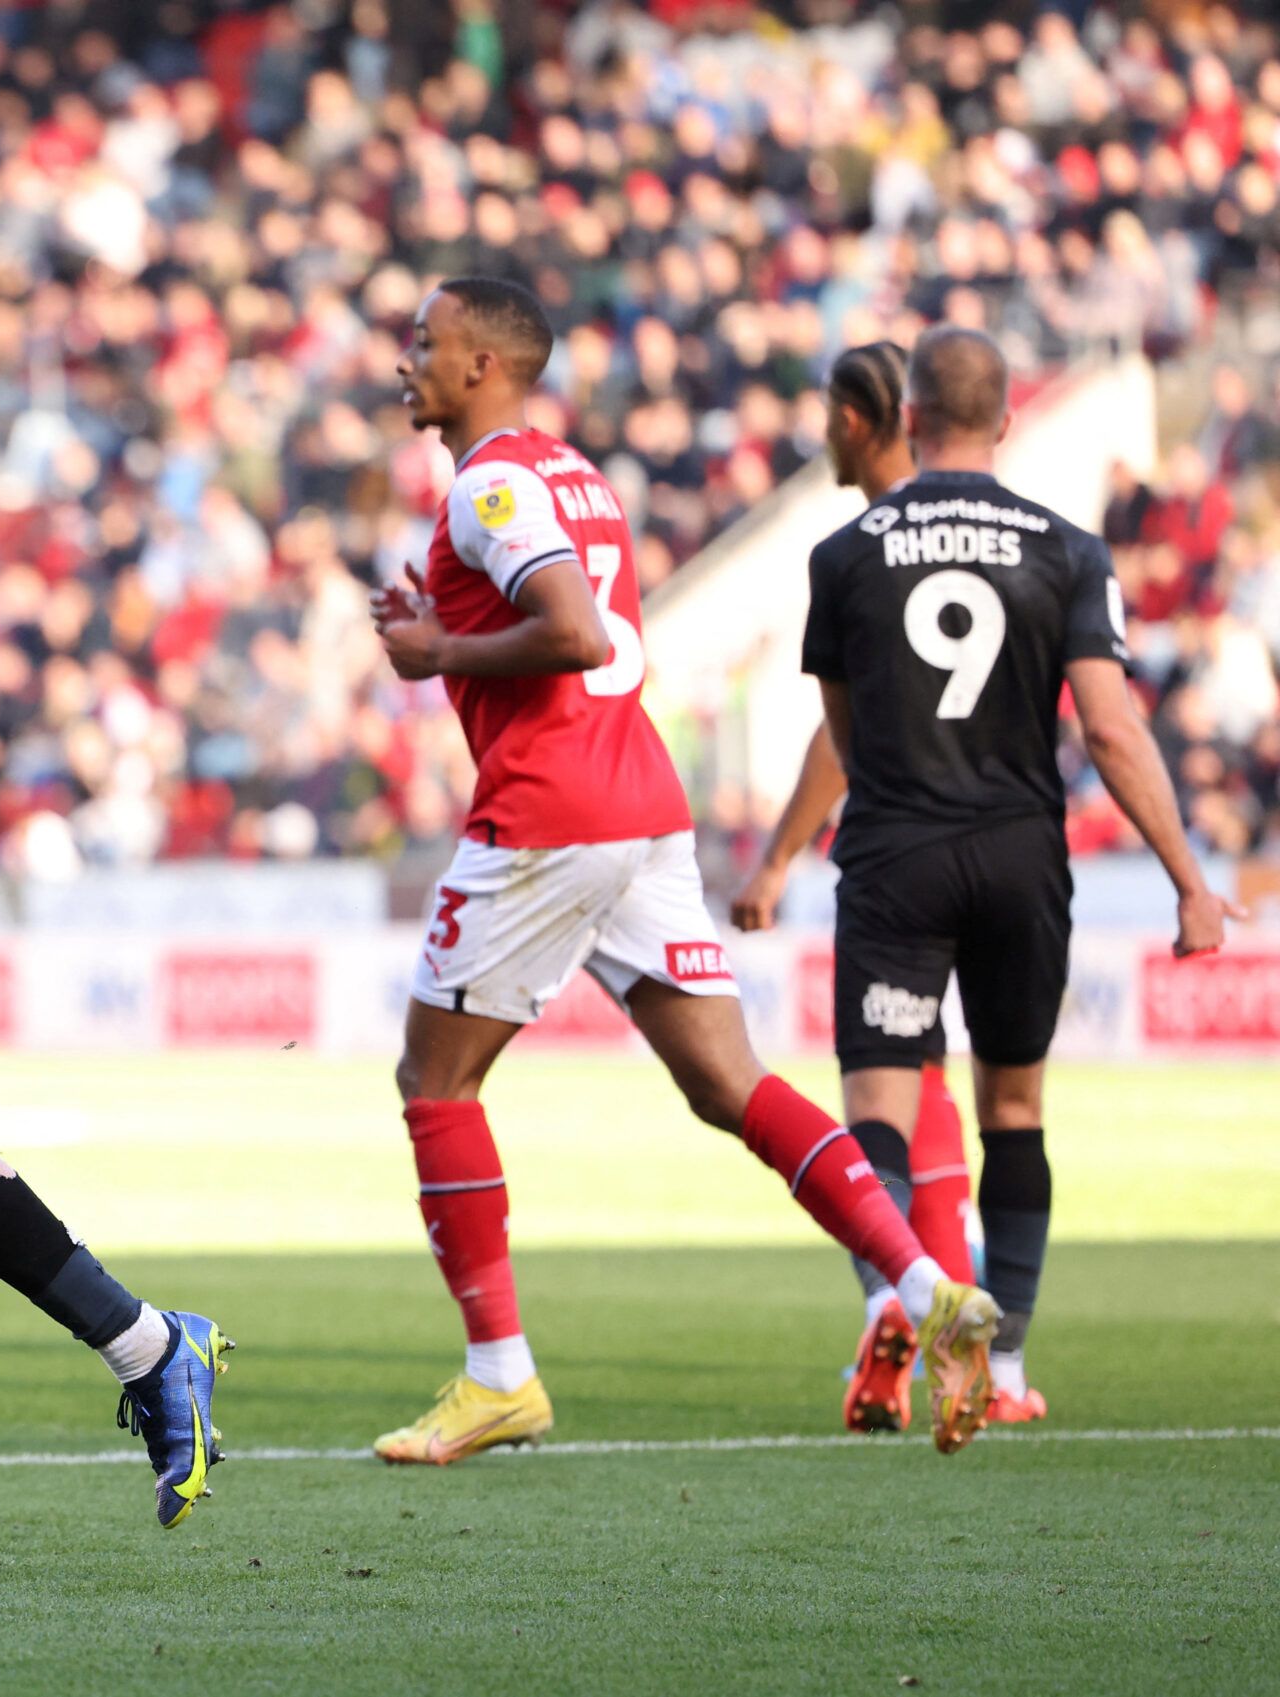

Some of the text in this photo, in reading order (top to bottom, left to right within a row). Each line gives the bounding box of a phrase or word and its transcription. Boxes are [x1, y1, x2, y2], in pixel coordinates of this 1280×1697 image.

[883, 523, 1022, 567] RHODES
[905, 498, 1050, 533] SportsBroker
[582, 544, 646, 696] 3
[904, 569, 1007, 720] 9
[428, 886, 469, 949] 3
